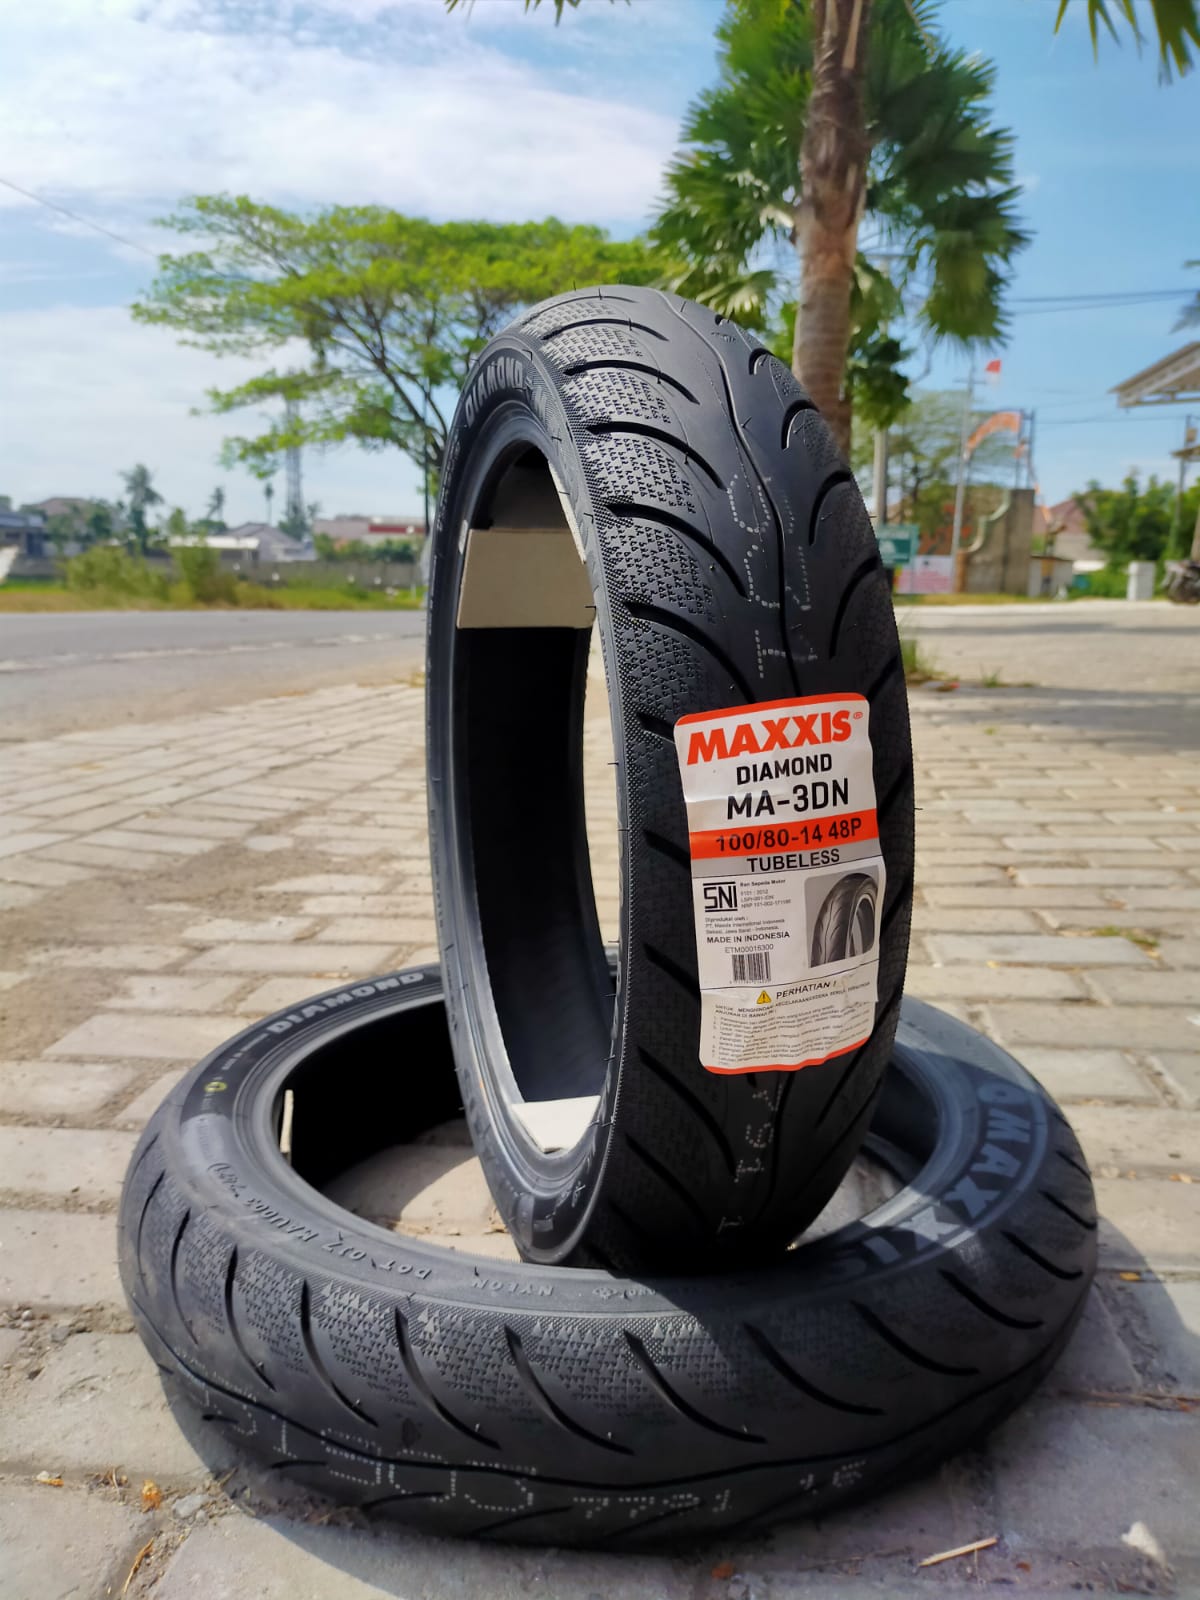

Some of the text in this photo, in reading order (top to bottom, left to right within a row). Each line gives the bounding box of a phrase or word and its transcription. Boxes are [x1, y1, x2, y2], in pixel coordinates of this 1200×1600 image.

[465, 356, 523, 429] DIAMOND
[687, 710, 852, 765] MAXXIS
[736, 753, 833, 785] DIAMOND
[727, 778, 849, 820] MA-3DN
[716, 817, 862, 852] 100/80-14 48P
[746, 848, 840, 873] TUBELESS
[703, 884, 738, 910] SNI
[706, 931, 790, 944] MADE IN INDONESIA
[266, 972, 425, 1035] DIAMOND
[776, 981, 831, 998] PERHATIAN
[471, 1278, 555, 1297] NYLON
